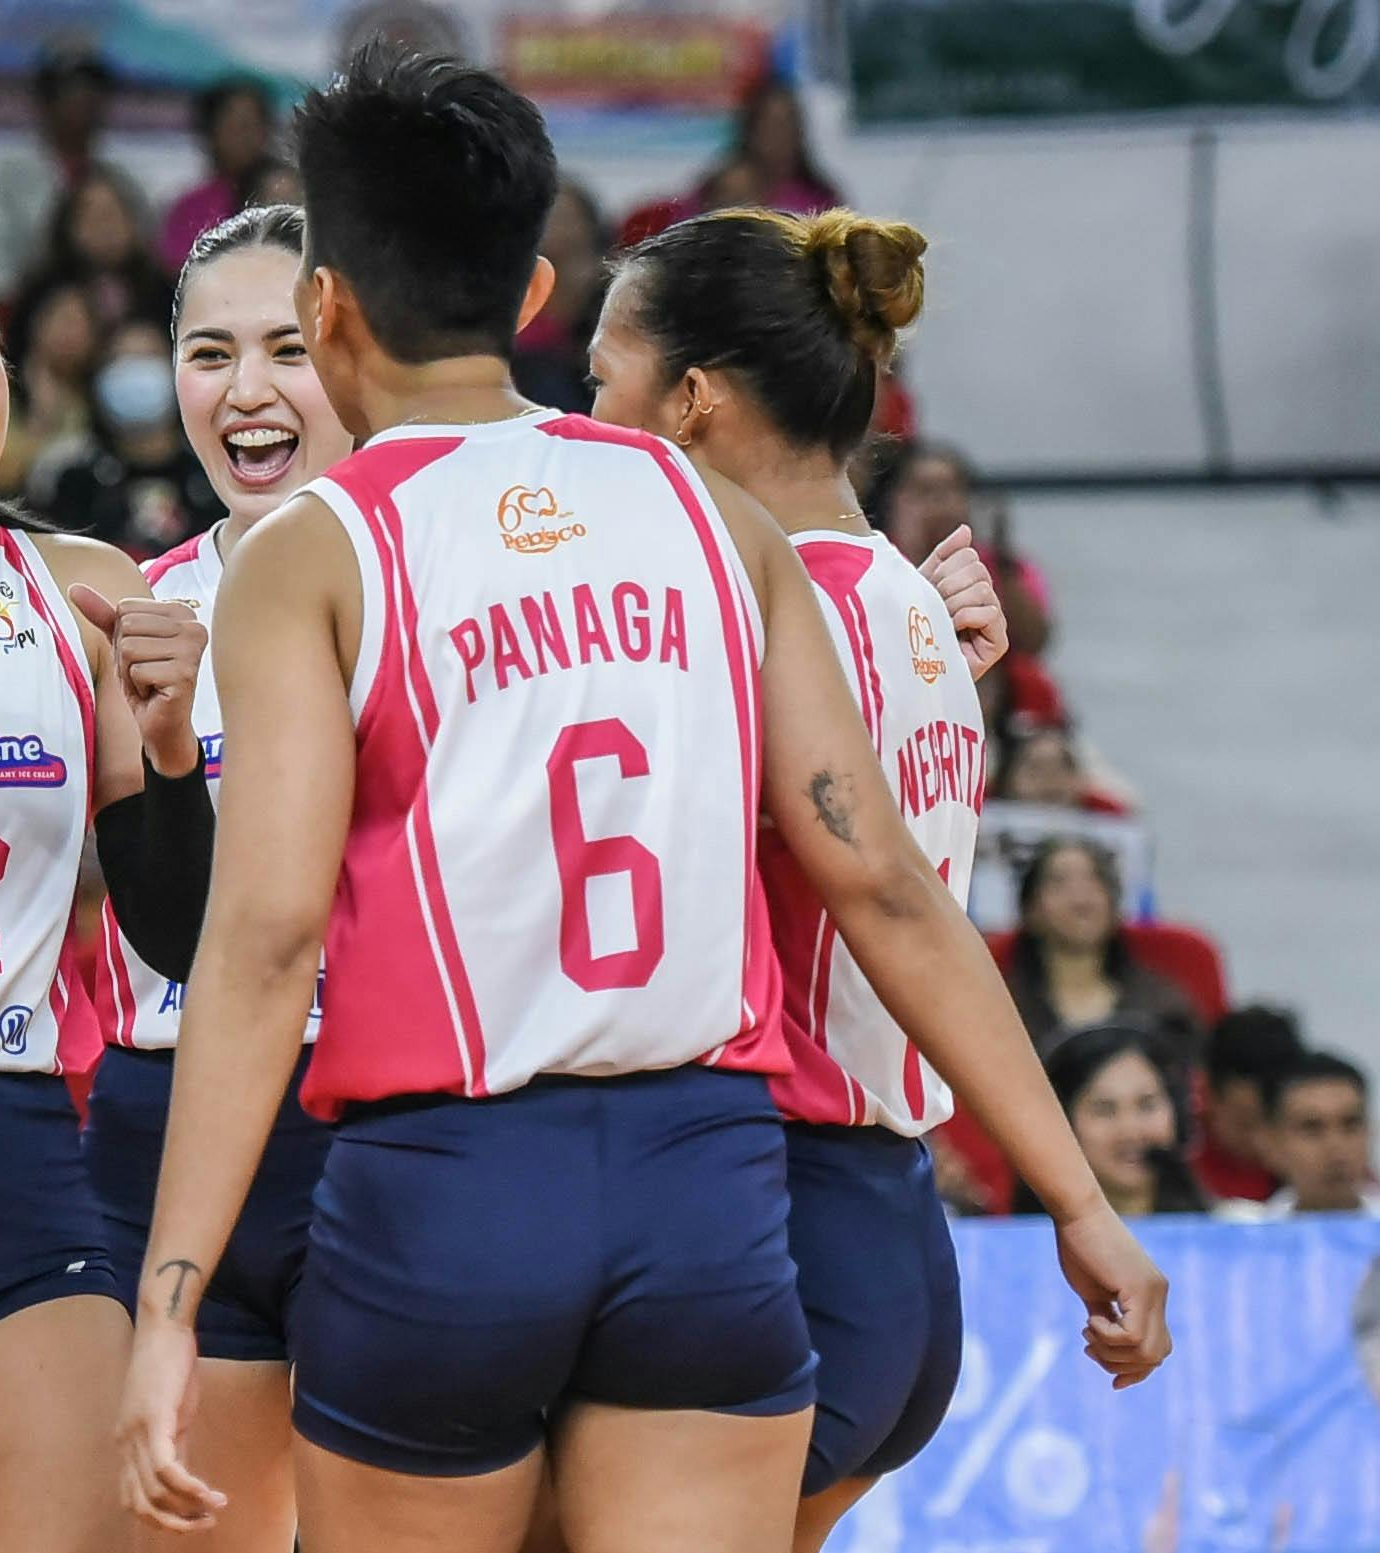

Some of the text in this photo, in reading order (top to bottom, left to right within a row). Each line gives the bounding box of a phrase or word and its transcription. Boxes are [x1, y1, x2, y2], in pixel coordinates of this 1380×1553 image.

[17, 627, 38, 648] PV
[448, 581, 689, 704] PANAGA
[18, 770, 31, 778] ICE
[32, 770, 56, 779] CREAM
[546, 717, 664, 993] 6
